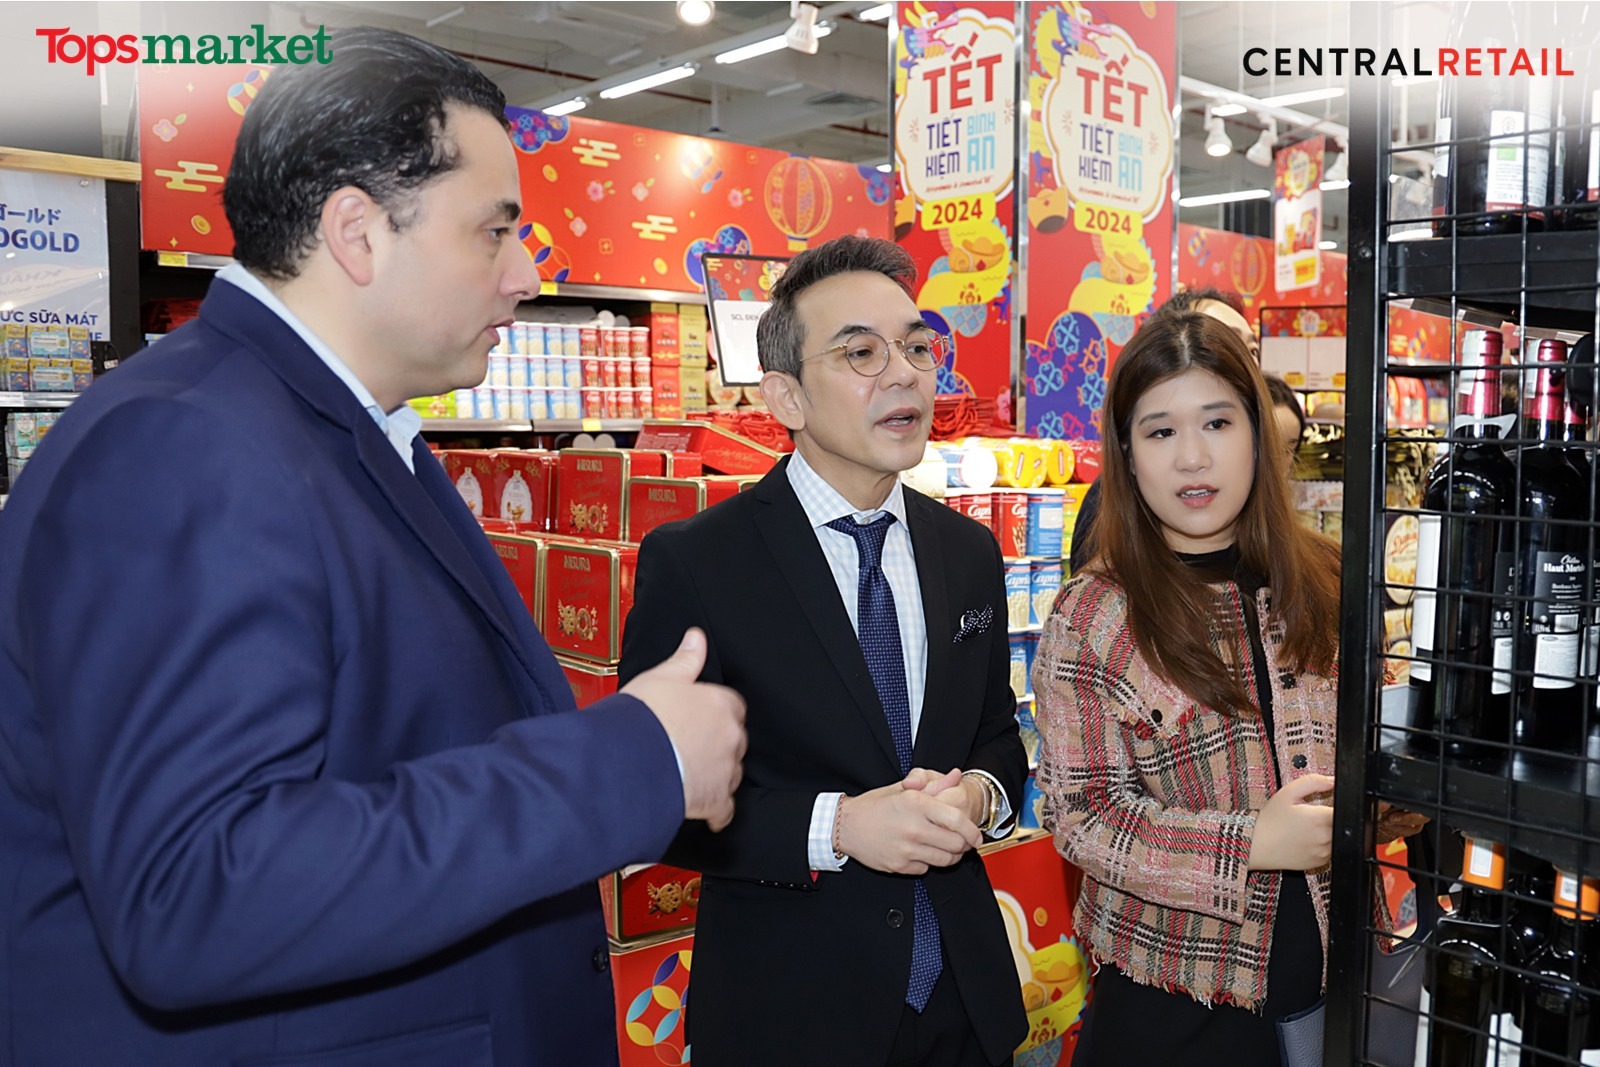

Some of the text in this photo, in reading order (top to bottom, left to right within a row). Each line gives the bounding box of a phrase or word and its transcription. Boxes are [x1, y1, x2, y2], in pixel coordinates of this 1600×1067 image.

[923, 32, 1002, 114] TẾT
[1076, 54, 1148, 127] TẾT
[926, 113, 962, 150] TIẾT
[1080, 123, 1114, 156] TIẾT
[925, 150, 961, 180] KIỆM
[966, 134, 995, 173] AN
[1078, 154, 1113, 185] KIỆM
[1117, 154, 1143, 193] AN
[932, 198, 983, 226] 2024
[1085, 207, 1132, 235] 2024
[66, 311, 98, 326] MÁT
[576, 458, 603, 473] MISURA
[648, 488, 677, 503] MISURA
[564, 555, 591, 572] MISURA
